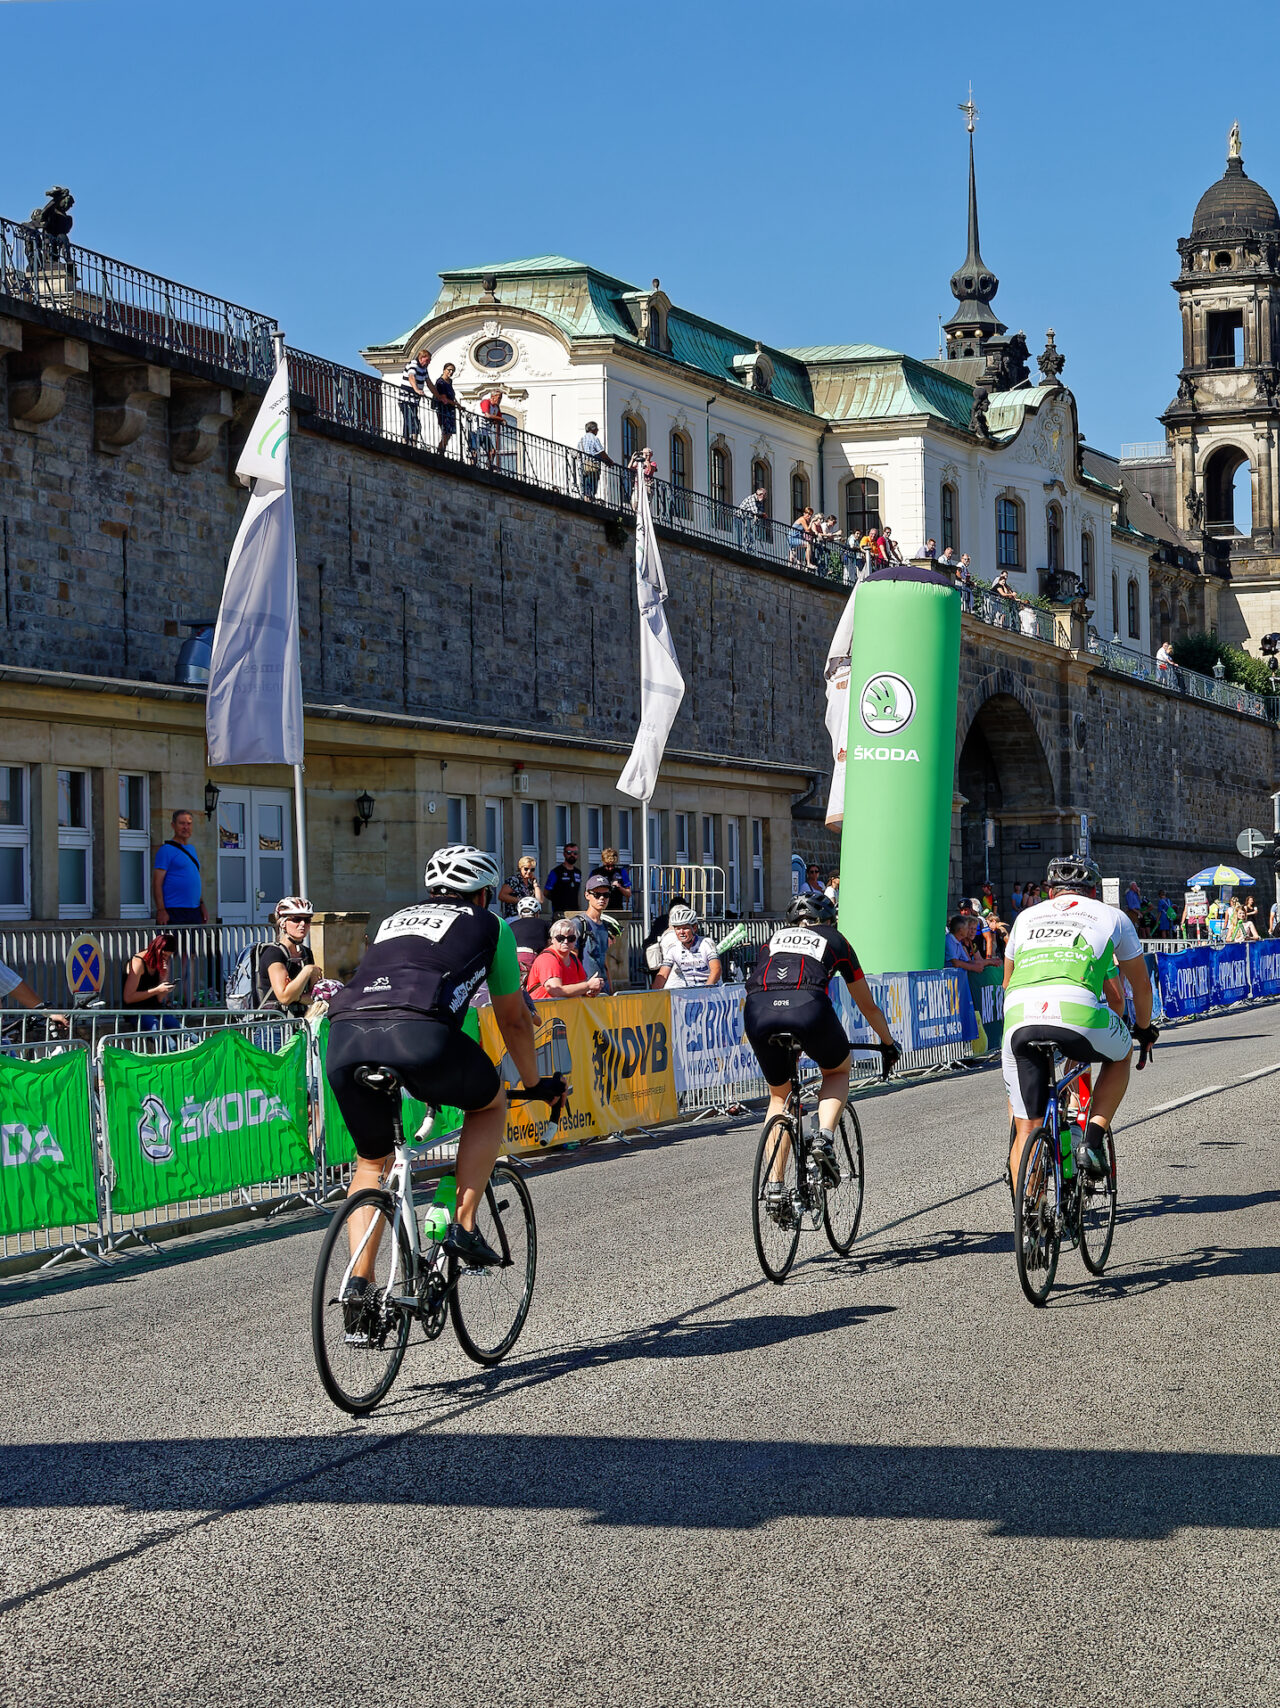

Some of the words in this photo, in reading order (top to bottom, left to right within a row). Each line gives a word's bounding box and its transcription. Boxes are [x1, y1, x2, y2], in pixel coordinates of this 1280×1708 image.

[853, 745, 920, 762] ŠKODA
[384, 916, 444, 931] 13043
[774, 935, 821, 949] 10054
[1027, 928, 1074, 941] 10296
[1053, 951, 1088, 961] CCW
[773, 999, 790, 1007] GORE
[621, 1022, 668, 1079] DVB
[180, 1088, 293, 1144] ŠKODA
[558, 1109, 596, 1132] resden.
